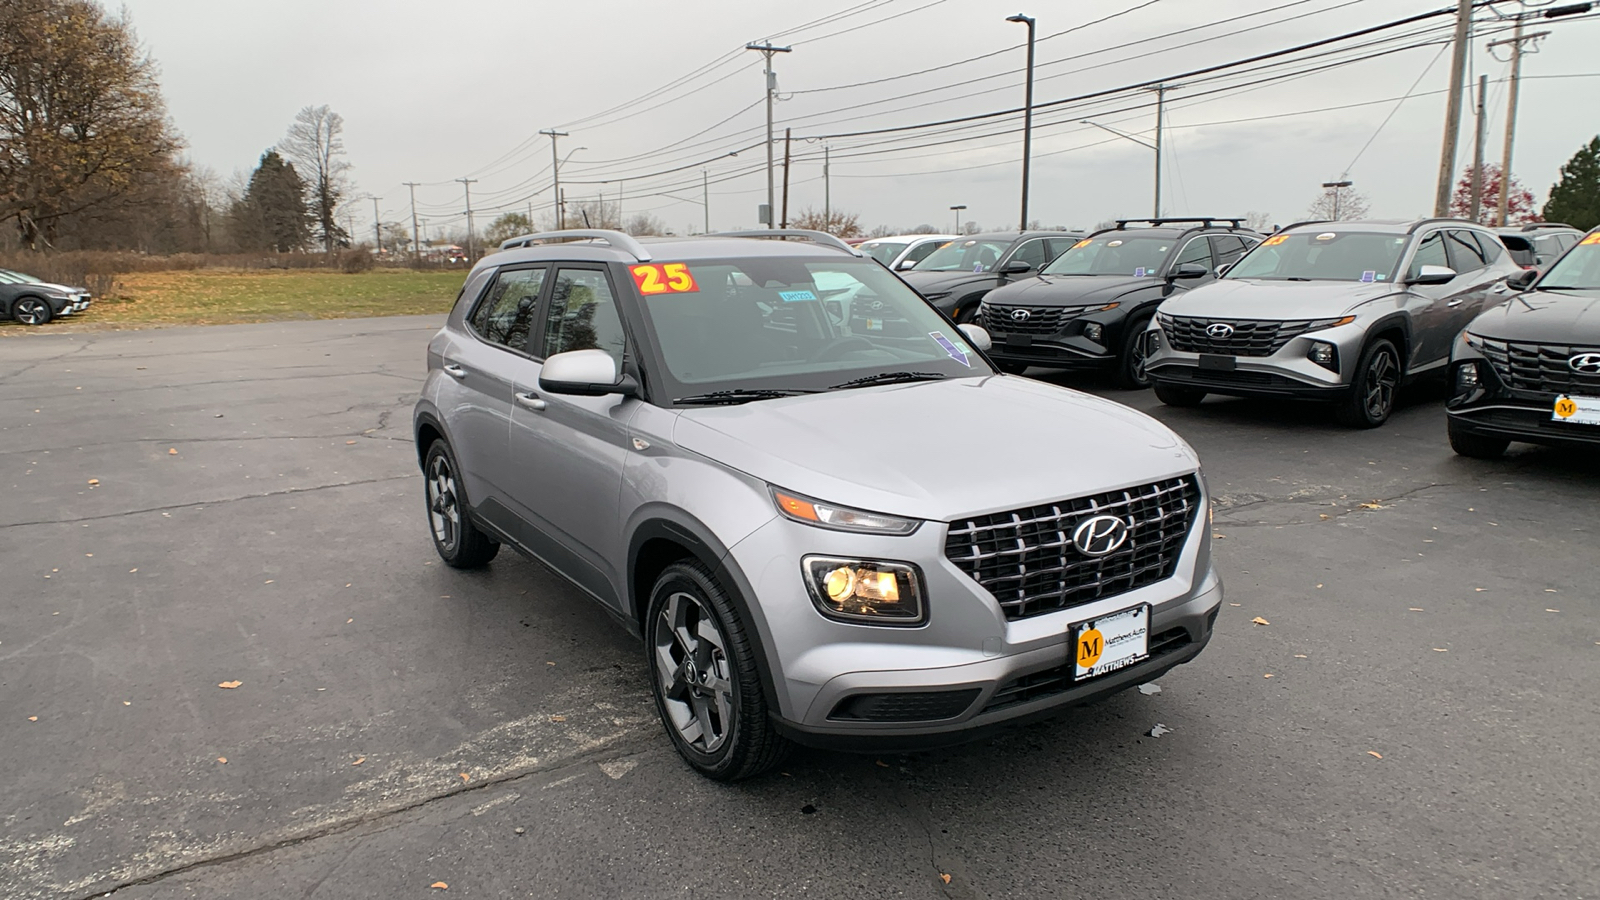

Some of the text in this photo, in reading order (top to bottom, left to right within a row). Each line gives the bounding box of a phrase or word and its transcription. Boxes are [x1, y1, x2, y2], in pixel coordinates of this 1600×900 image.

[633, 263, 693, 293] 25
[1558, 403, 1573, 413] M
[1080, 637, 1099, 660] M
[1092, 655, 1134, 677] MATTHEWS
